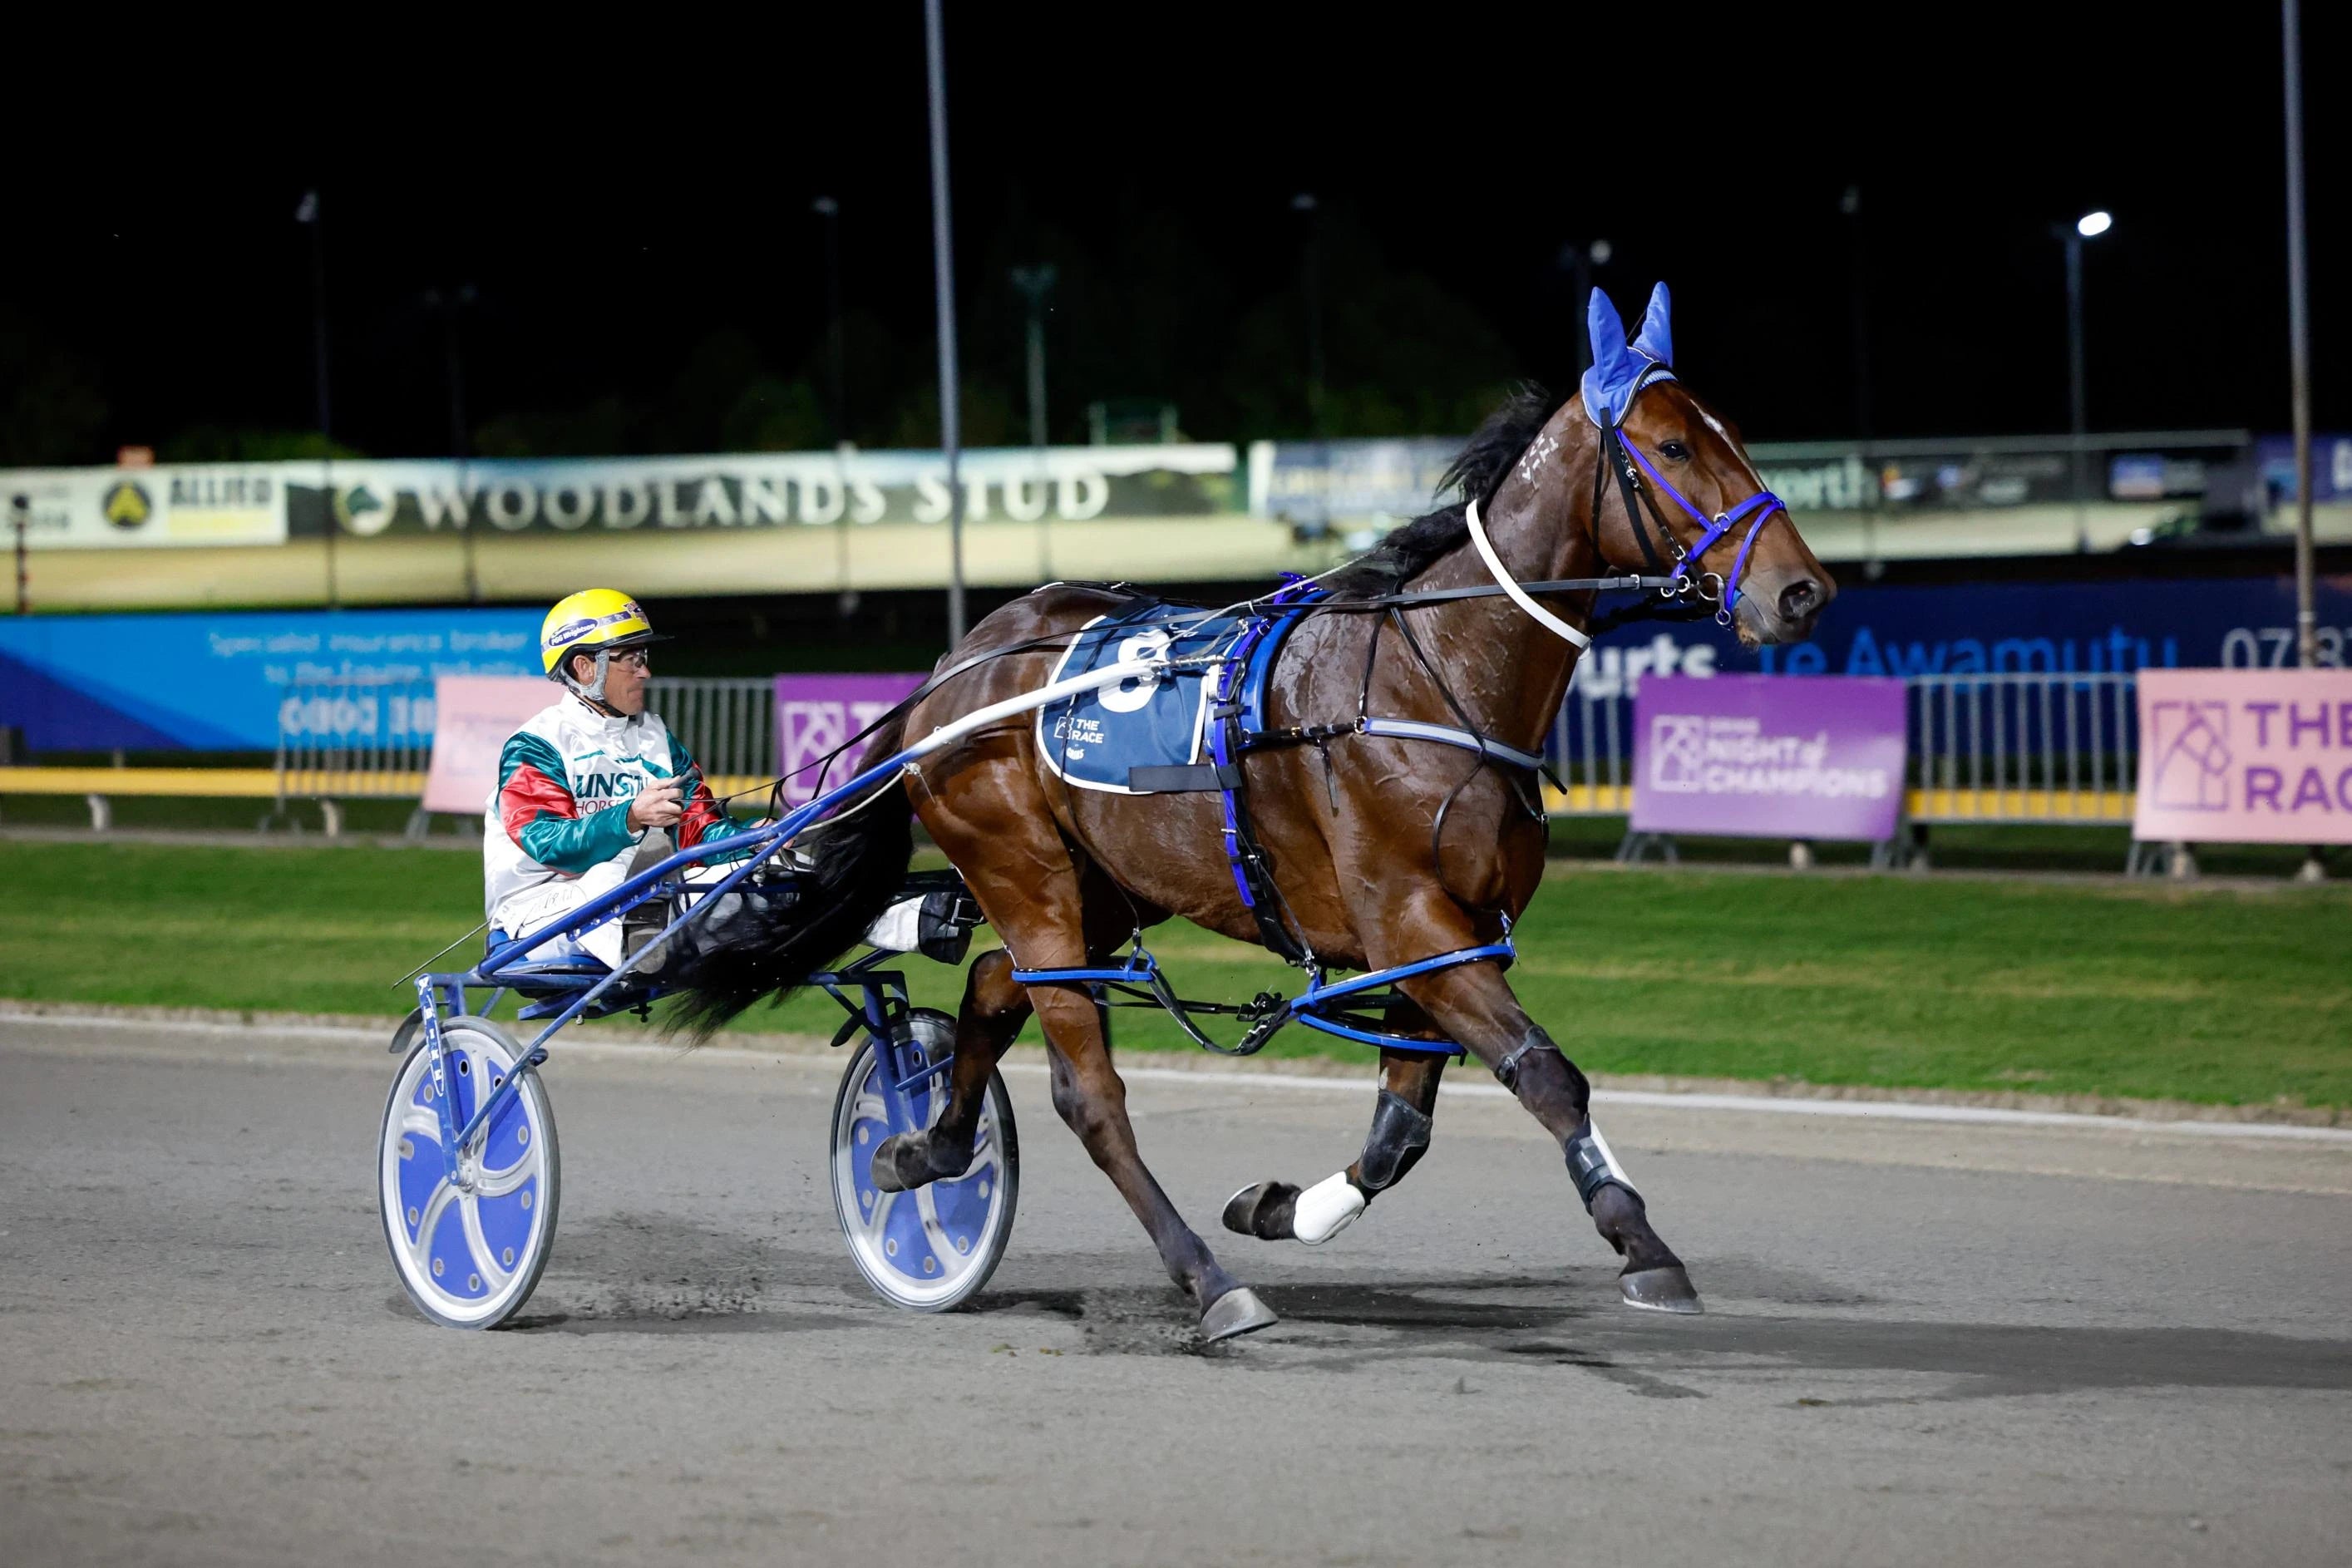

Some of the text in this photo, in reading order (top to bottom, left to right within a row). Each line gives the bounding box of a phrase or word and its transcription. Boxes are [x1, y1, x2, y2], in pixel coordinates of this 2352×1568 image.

[417, 468, 1110, 530] WOODLANDS STUD
[564, 623, 595, 640] Wrightson
[1097, 629, 1171, 713] 8
[1577, 633, 1718, 698] urts
[1071, 730, 1104, 744] RACE
[1076, 718, 1100, 731] THE
